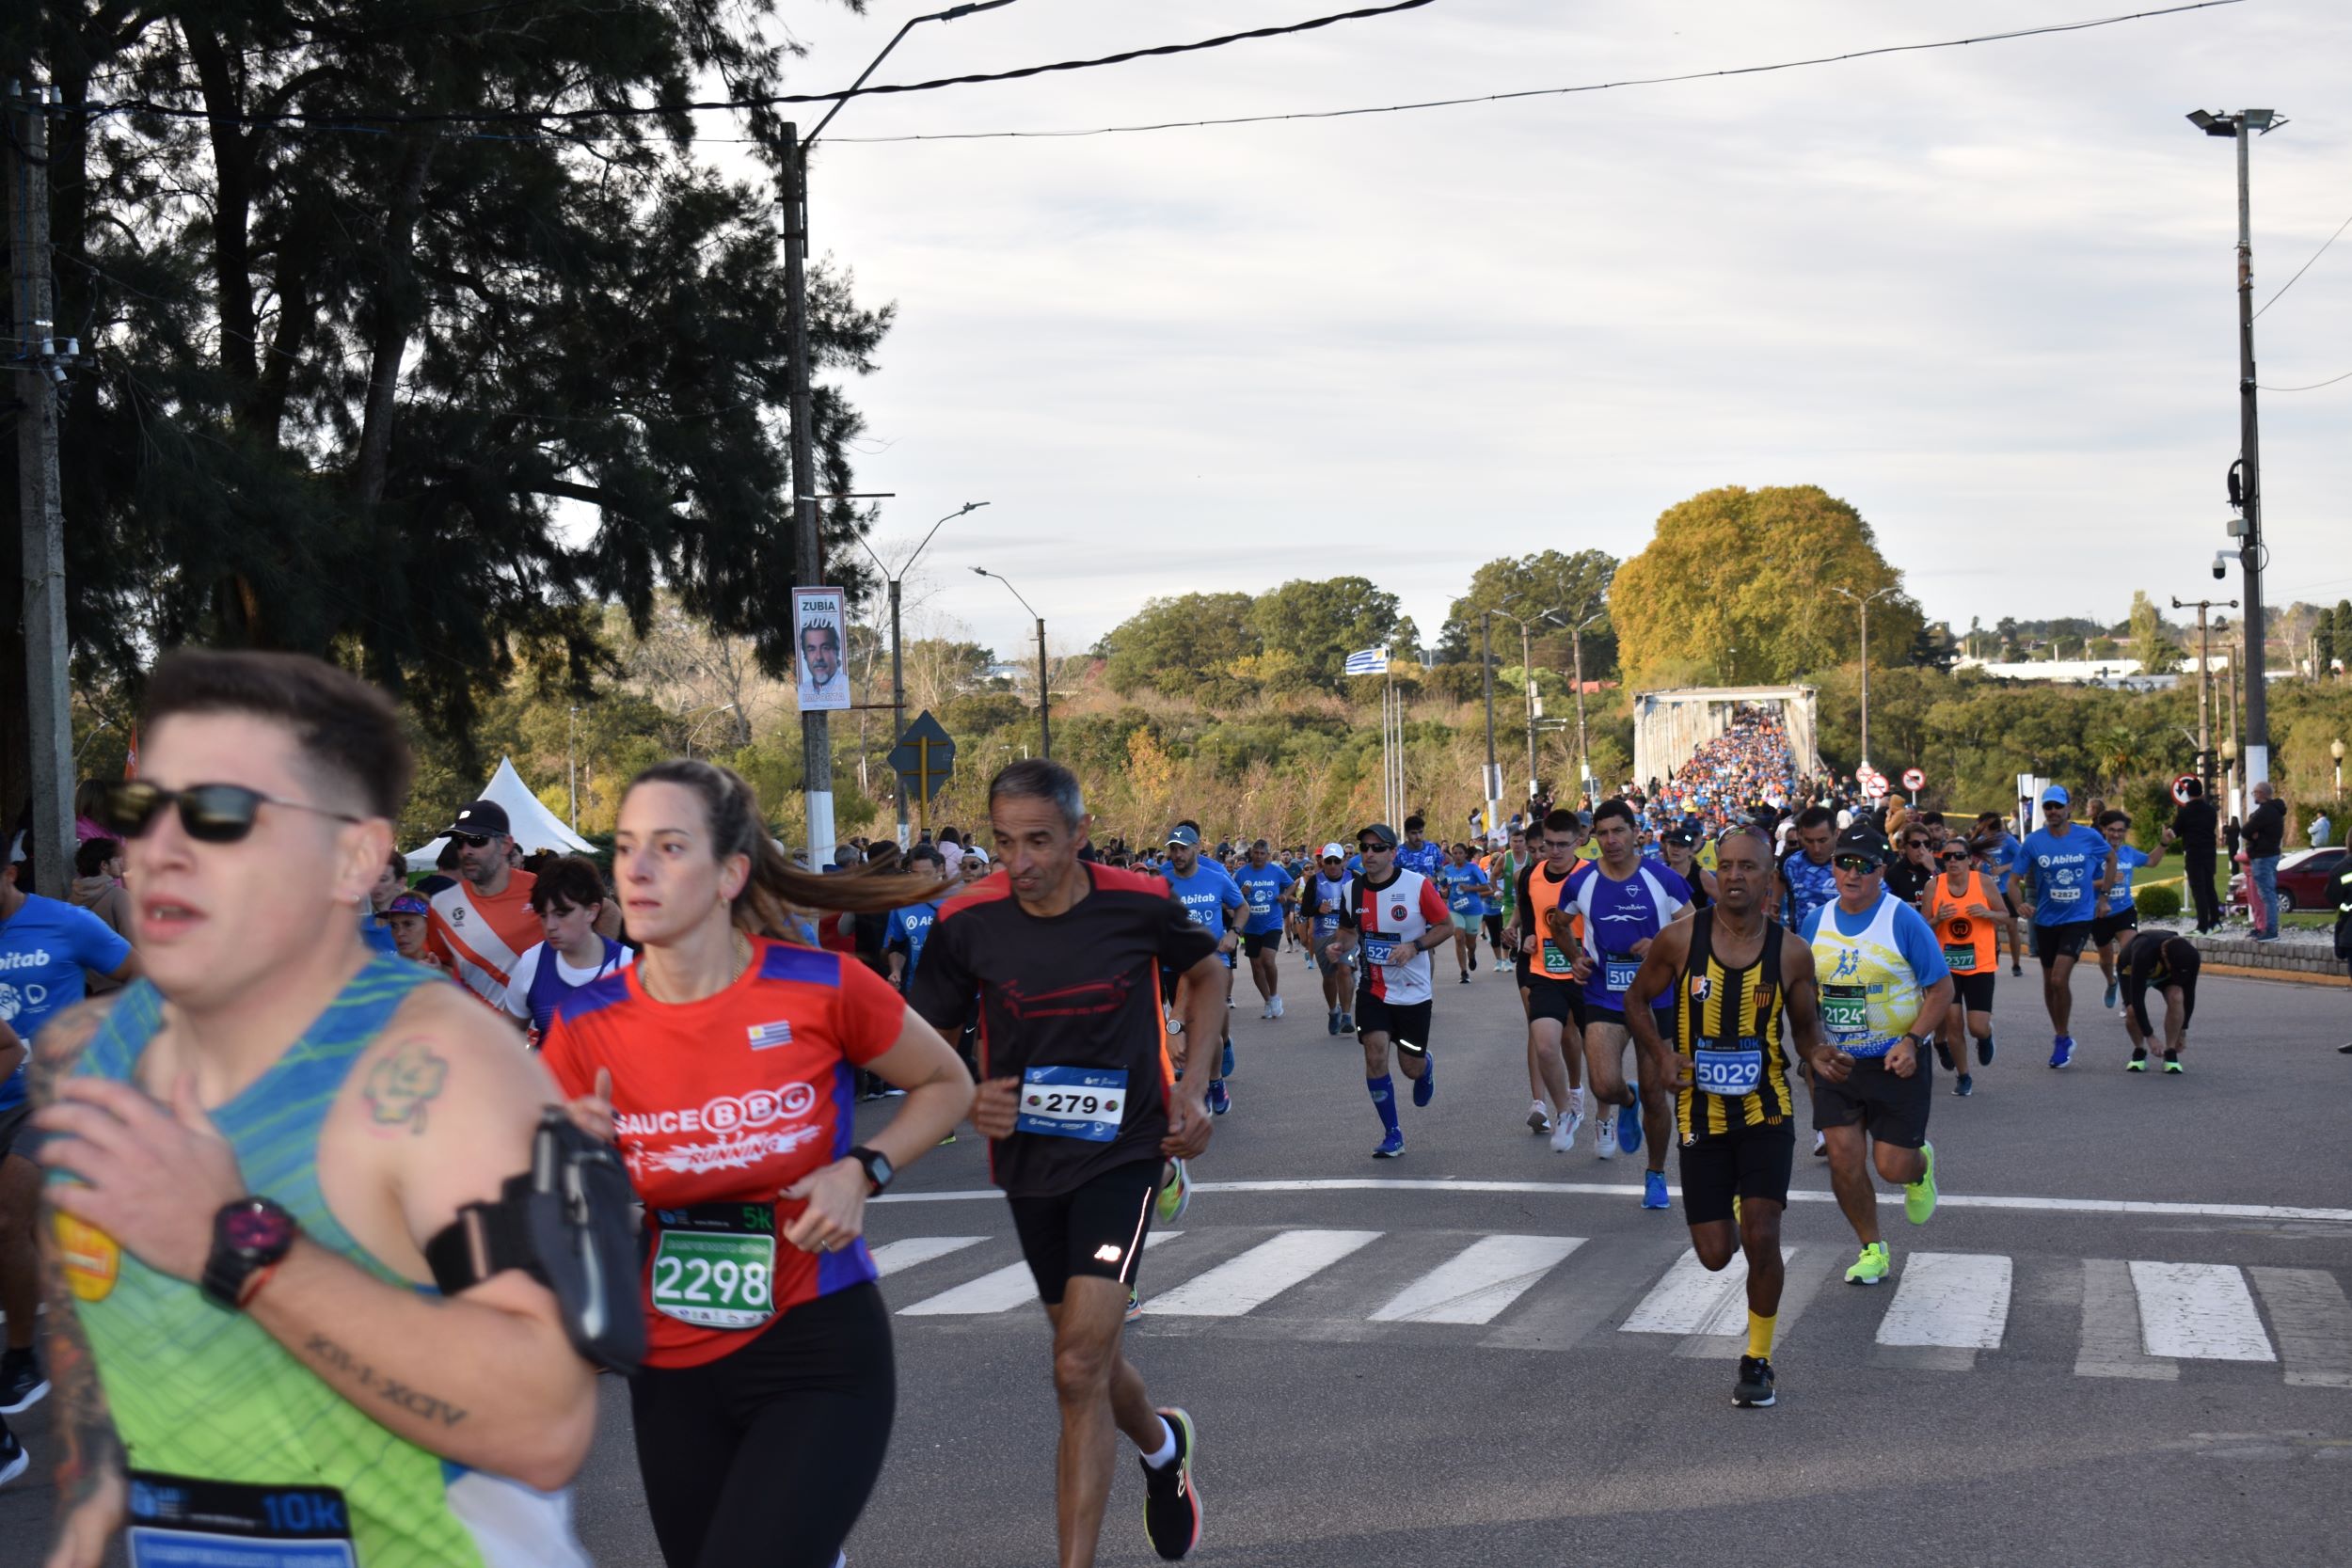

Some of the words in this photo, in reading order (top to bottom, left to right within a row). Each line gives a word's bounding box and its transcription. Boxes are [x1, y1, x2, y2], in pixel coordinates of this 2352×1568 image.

[2052, 853, 2085, 864] Abitab
[1325, 917, 1340, 926] 514
[1547, 955, 1571, 966] 23
[1946, 955, 1974, 965] 2377
[1824, 1006, 1862, 1023] 2124
[1698, 1063, 1759, 1084] 5029
[614, 1108, 700, 1134] SAUCE
[710, 1085, 809, 1128] BBC
[1045, 1093, 1099, 1114] 279
[690, 1139, 779, 1164] RUNNING
[656, 1256, 768, 1306] 2298
